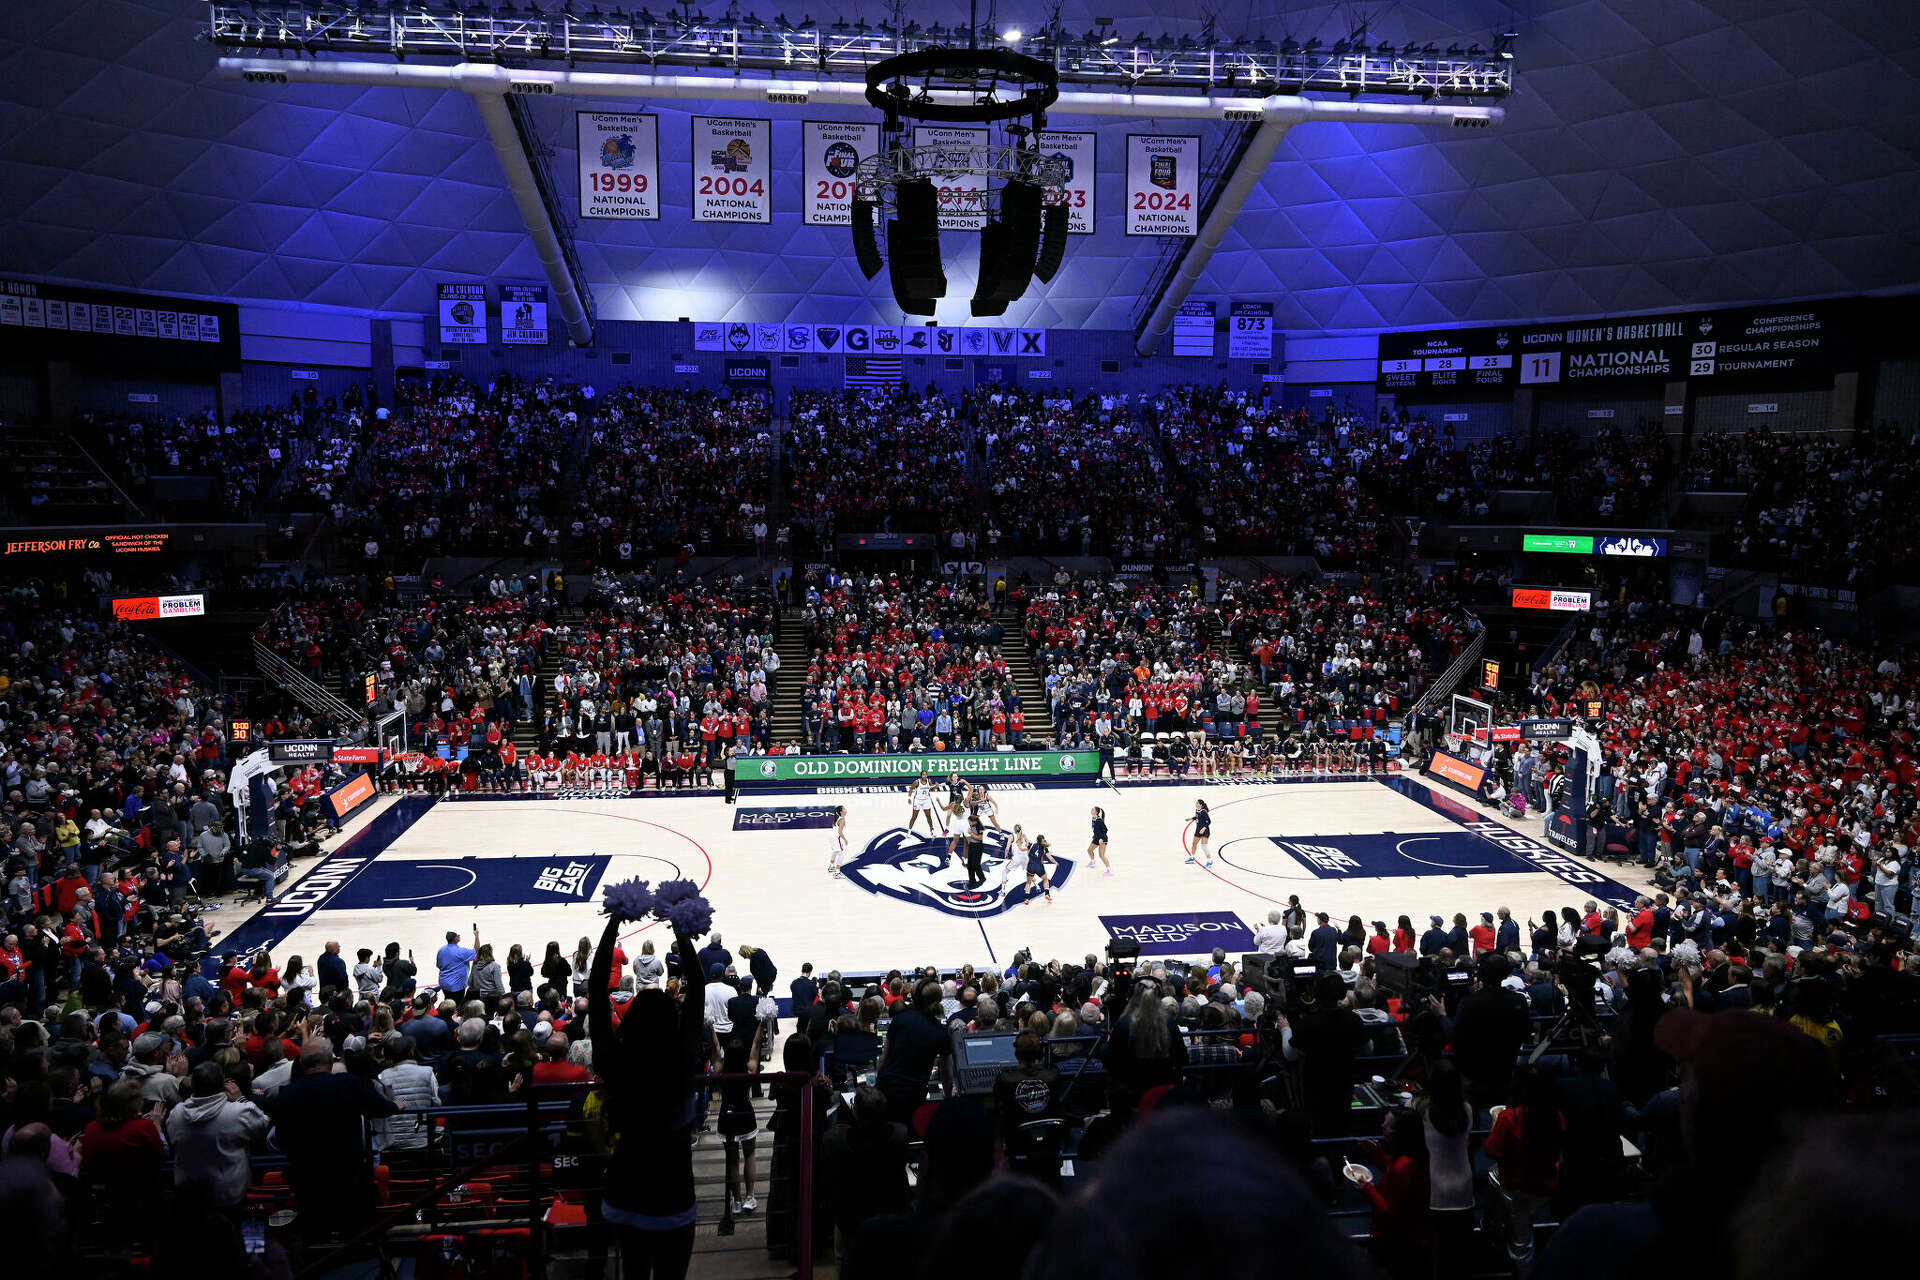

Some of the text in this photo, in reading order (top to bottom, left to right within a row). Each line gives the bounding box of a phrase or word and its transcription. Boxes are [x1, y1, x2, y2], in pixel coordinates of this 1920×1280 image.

[592, 114, 619, 122] UConn
[707, 119, 733, 127] UConn
[597, 124, 639, 132] Basketball
[711, 128, 752, 137] Basketball
[818, 124, 866, 133] UConn Men's
[822, 132, 862, 141] Basketball
[928, 129, 975, 138] UConn Men's
[1039, 133, 1083, 142] Conn Men's
[1040, 142, 1078, 150] Basketball
[1140, 137, 1187, 145] UConn Men's
[1145, 145, 1182, 153] Basketball
[590, 172, 648, 193] 1999
[699, 175, 764, 197] 2004
[593, 196, 646, 205] NATIONAL
[938, 186, 979, 207] 014
[1133, 192, 1192, 211] 2024
[706, 199, 758, 209] NATIONAL
[816, 202, 852, 210] NATION
[589, 207, 651, 217] CHAMPIONS
[702, 209, 762, 220] CHAMPIONS
[812, 213, 852, 222] CHAMPI
[1138, 214, 1186, 223] NATIONAL
[936, 219, 979, 228] AMPIONS
[1134, 225, 1190, 234] CHAMPIONS
[116, 308, 133, 320] 22
[140, 310, 153, 321] 13
[159, 312, 176, 323] 22
[180, 314, 197, 325] 42
[1237, 318, 1265, 330] 873
[1752, 313, 1815, 326] CONFERENCE
[1523, 321, 1684, 344] UCONN WOMEN'S BASKETBALL
[1745, 321, 1822, 335] CHAMPIONSHIPS
[846, 328, 869, 351] G
[1021, 332, 1042, 353] X
[1695, 338, 1820, 354] 30 REGULAR SEASON
[1412, 347, 1464, 356] TOURNAMENT
[1484, 358, 1498, 367] 23
[1569, 349, 1670, 368] NATIONAL
[1396, 362, 1408, 370] 31
[1439, 360, 1452, 369] 28
[1532, 358, 1550, 377] 11
[1694, 358, 1795, 372] 29 TOURNAMENT
[730, 367, 767, 377] UCONN
[1432, 371, 1457, 379] ELITE
[1476, 370, 1502, 378] FINAL
[1568, 363, 1670, 378] CHAMPIONSHIPS
[1385, 373, 1416, 381] SWEET
[1475, 376, 1503, 384] FOURS
[5, 540, 66, 554] JEFFERSON
[68, 539, 88, 550] FRY
[162, 600, 201, 609] PROBLEM
[1553, 596, 1588, 604] PROBLEM
[115, 600, 155, 617] Coca-Cola
[162, 606, 201, 615] GAMBLING
[1485, 672, 1497, 687] 30
[1588, 709, 1600, 717] 30
[233, 730, 247, 739] 30
[794, 757, 1043, 776] OLD DOMINION FREIGHT LINE
[817, 785, 902, 794] BASKETBALL
[740, 810, 838, 820] MADISON
[1549, 829, 1578, 849] TRAVELERS
[1314, 845, 1362, 867] BIG
[1463, 821, 1606, 883] HUSKIES
[1292, 843, 1350, 873] EAST
[533, 866, 565, 891] BIG
[555, 860, 590, 895] EAST
[262, 857, 368, 916] UCONN
[1112, 921, 1244, 935] MADISON
[554, 1156, 580, 1168] SEC
